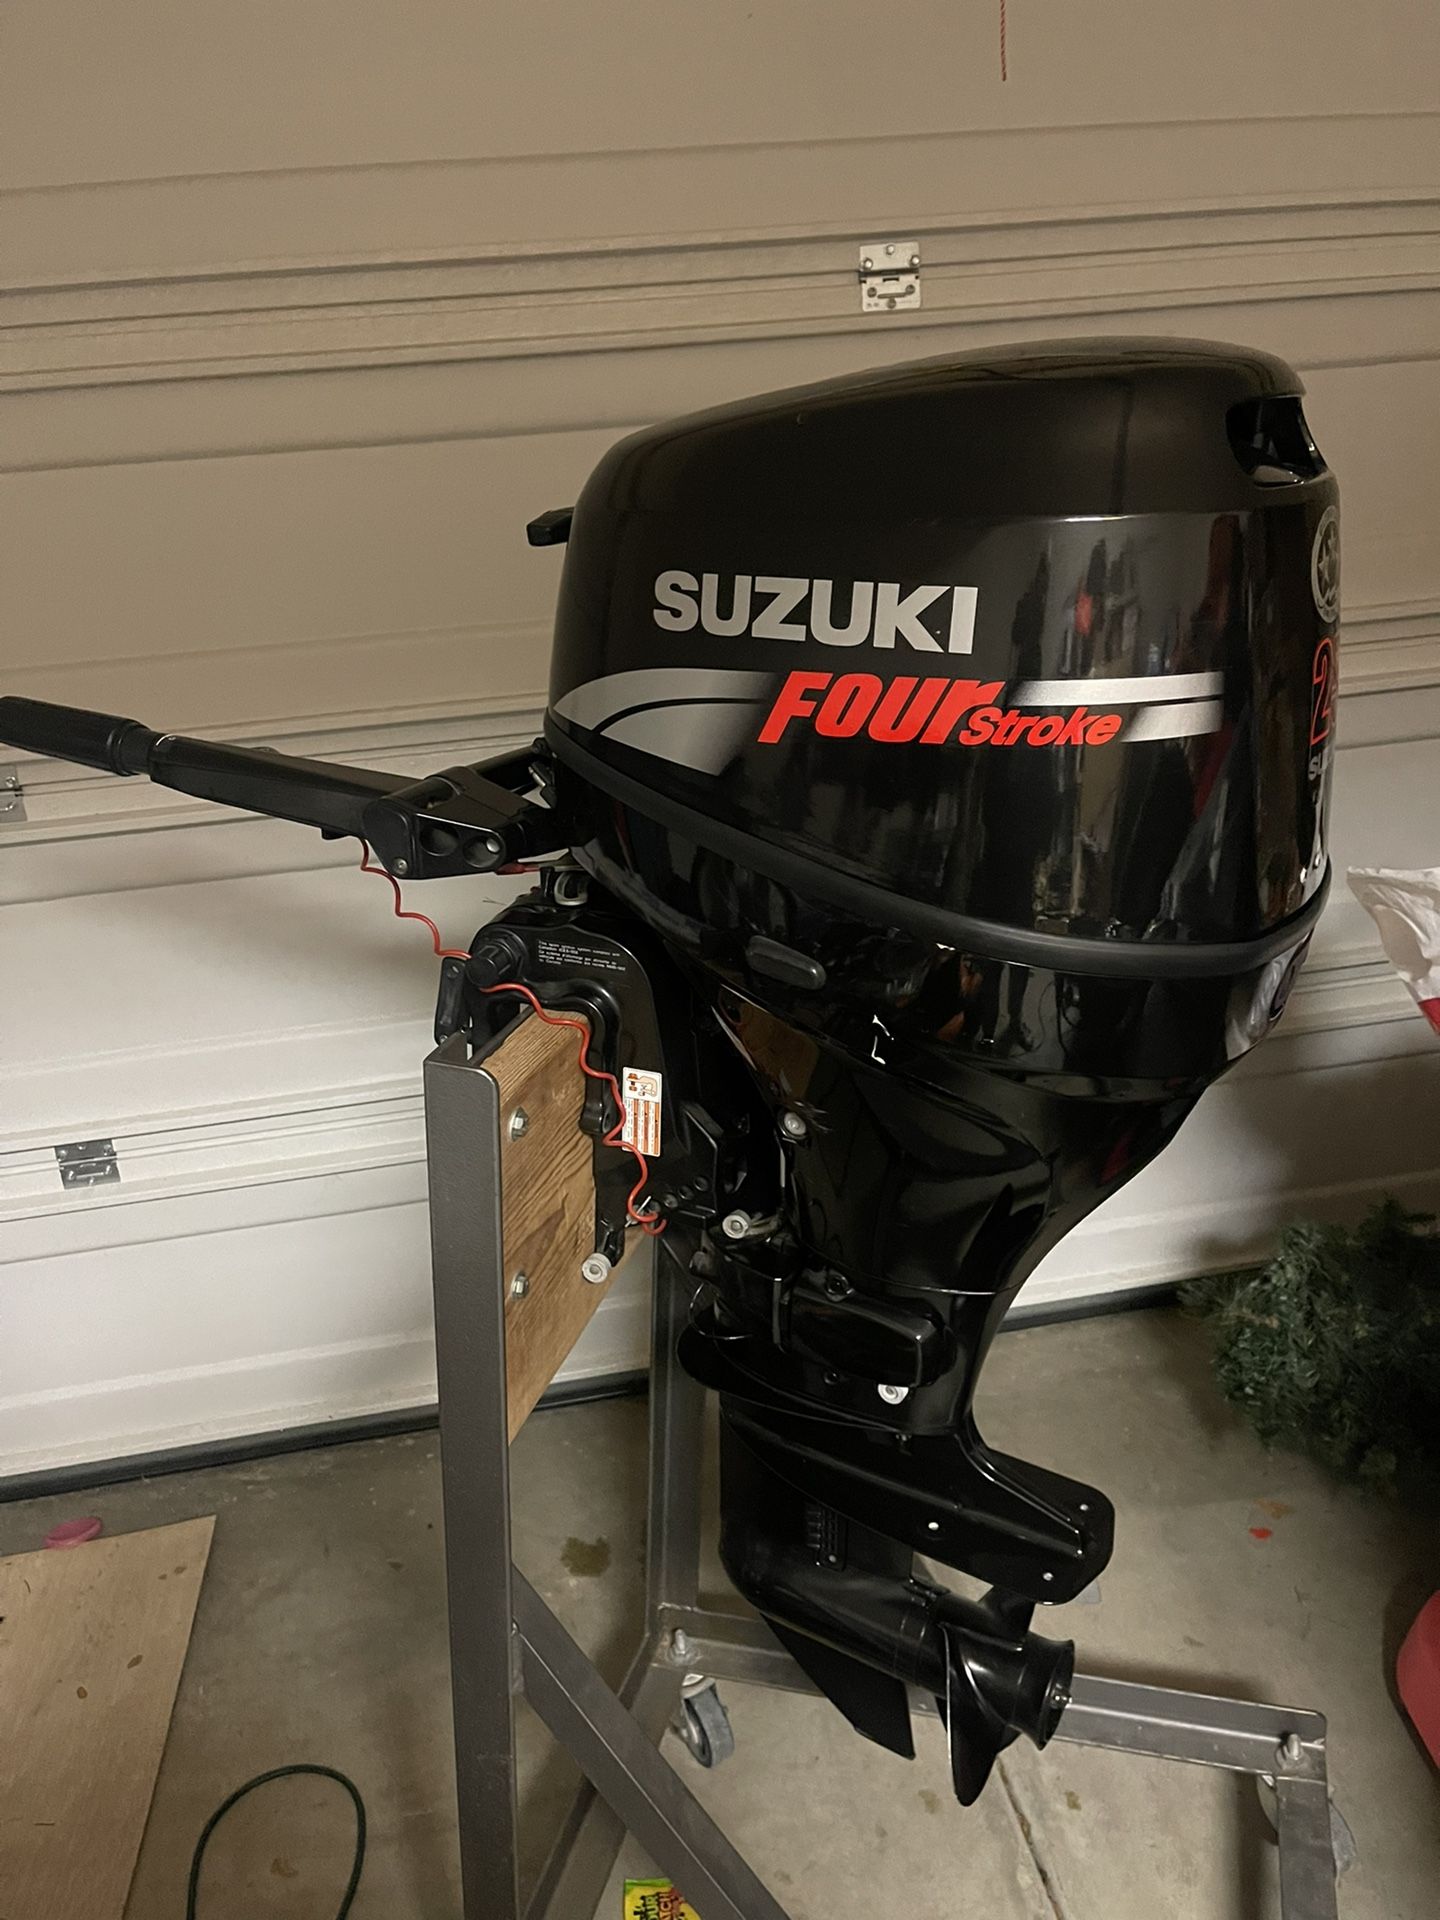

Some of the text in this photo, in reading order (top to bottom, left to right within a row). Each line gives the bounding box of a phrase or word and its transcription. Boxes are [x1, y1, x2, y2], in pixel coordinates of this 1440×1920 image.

[653, 570, 978, 654] SUZUKI
[1310, 637, 1336, 745] 2
[958, 706, 1122, 748] Stroke
[644, 1896, 659, 1920] OUR
